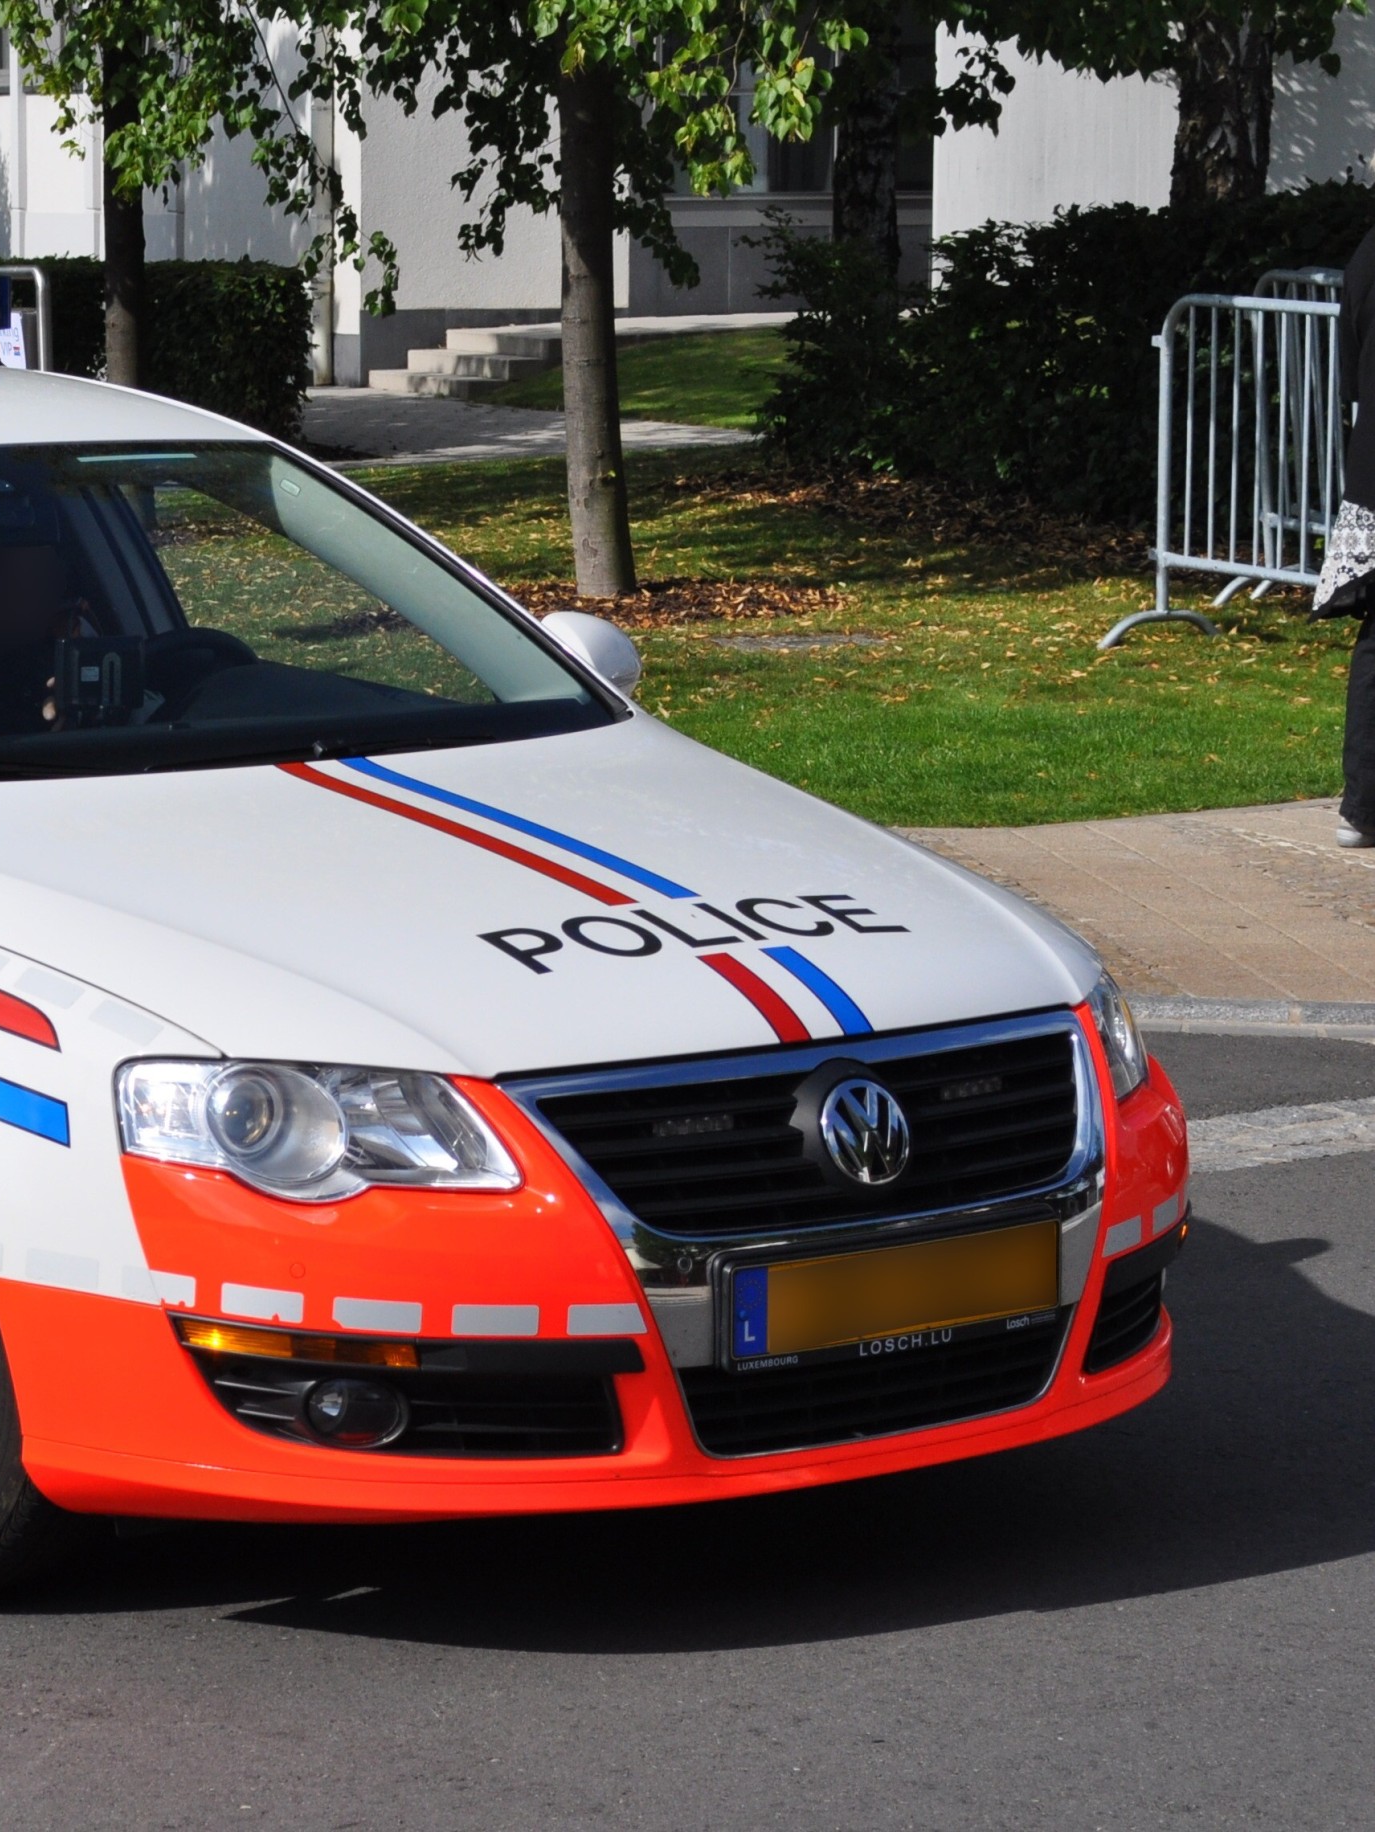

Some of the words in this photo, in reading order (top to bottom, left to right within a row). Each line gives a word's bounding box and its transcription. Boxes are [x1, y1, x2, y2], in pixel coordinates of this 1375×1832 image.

[476, 894, 911, 975] POLICE
[744, 1320, 756, 1342] L
[859, 1328, 953, 1357] LOSCH.LU
[737, 1355, 799, 1372] LUXEMBOURG
